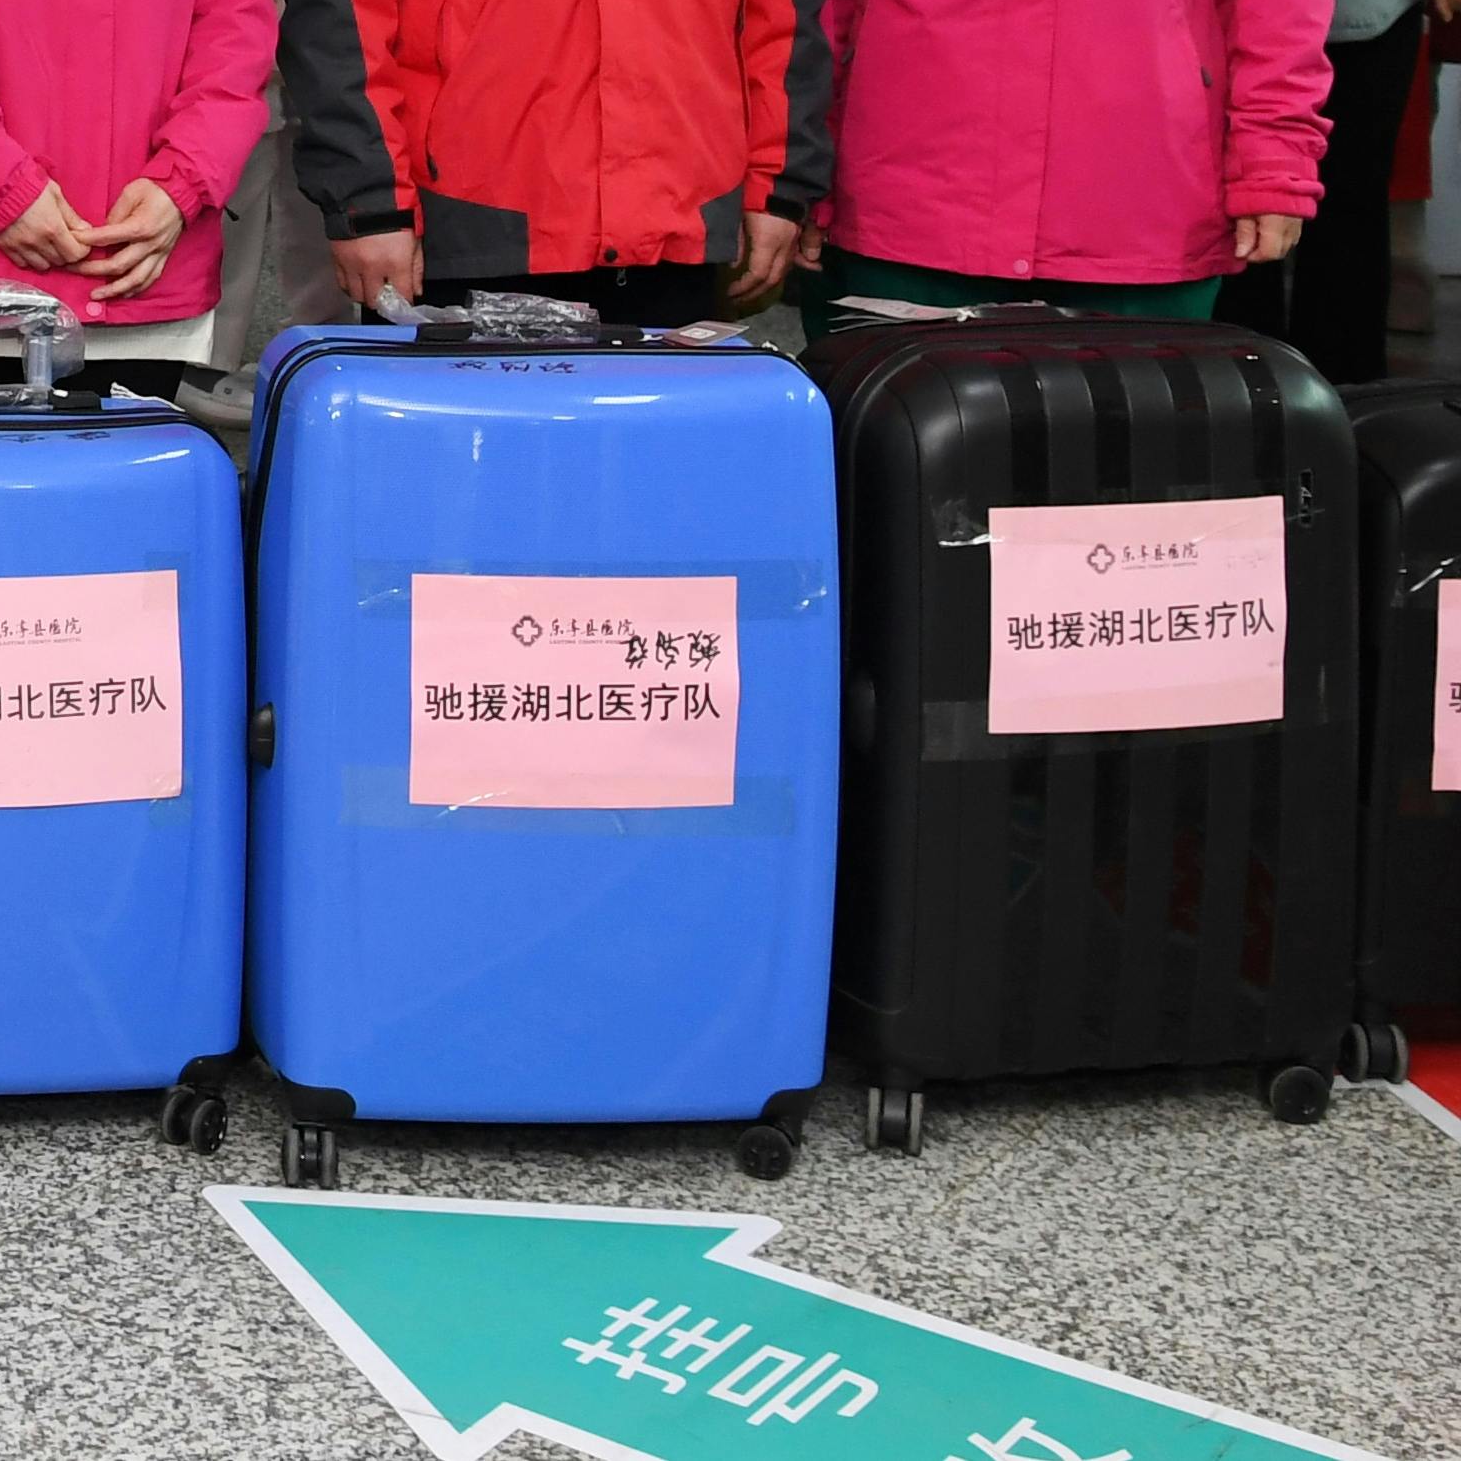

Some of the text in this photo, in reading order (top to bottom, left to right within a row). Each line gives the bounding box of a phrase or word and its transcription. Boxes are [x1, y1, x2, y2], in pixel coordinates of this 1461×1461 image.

[1007, 598, 1275, 650] 驰援湖北医疗队
[423, 682, 722, 723] 驰援湖北医疗队
